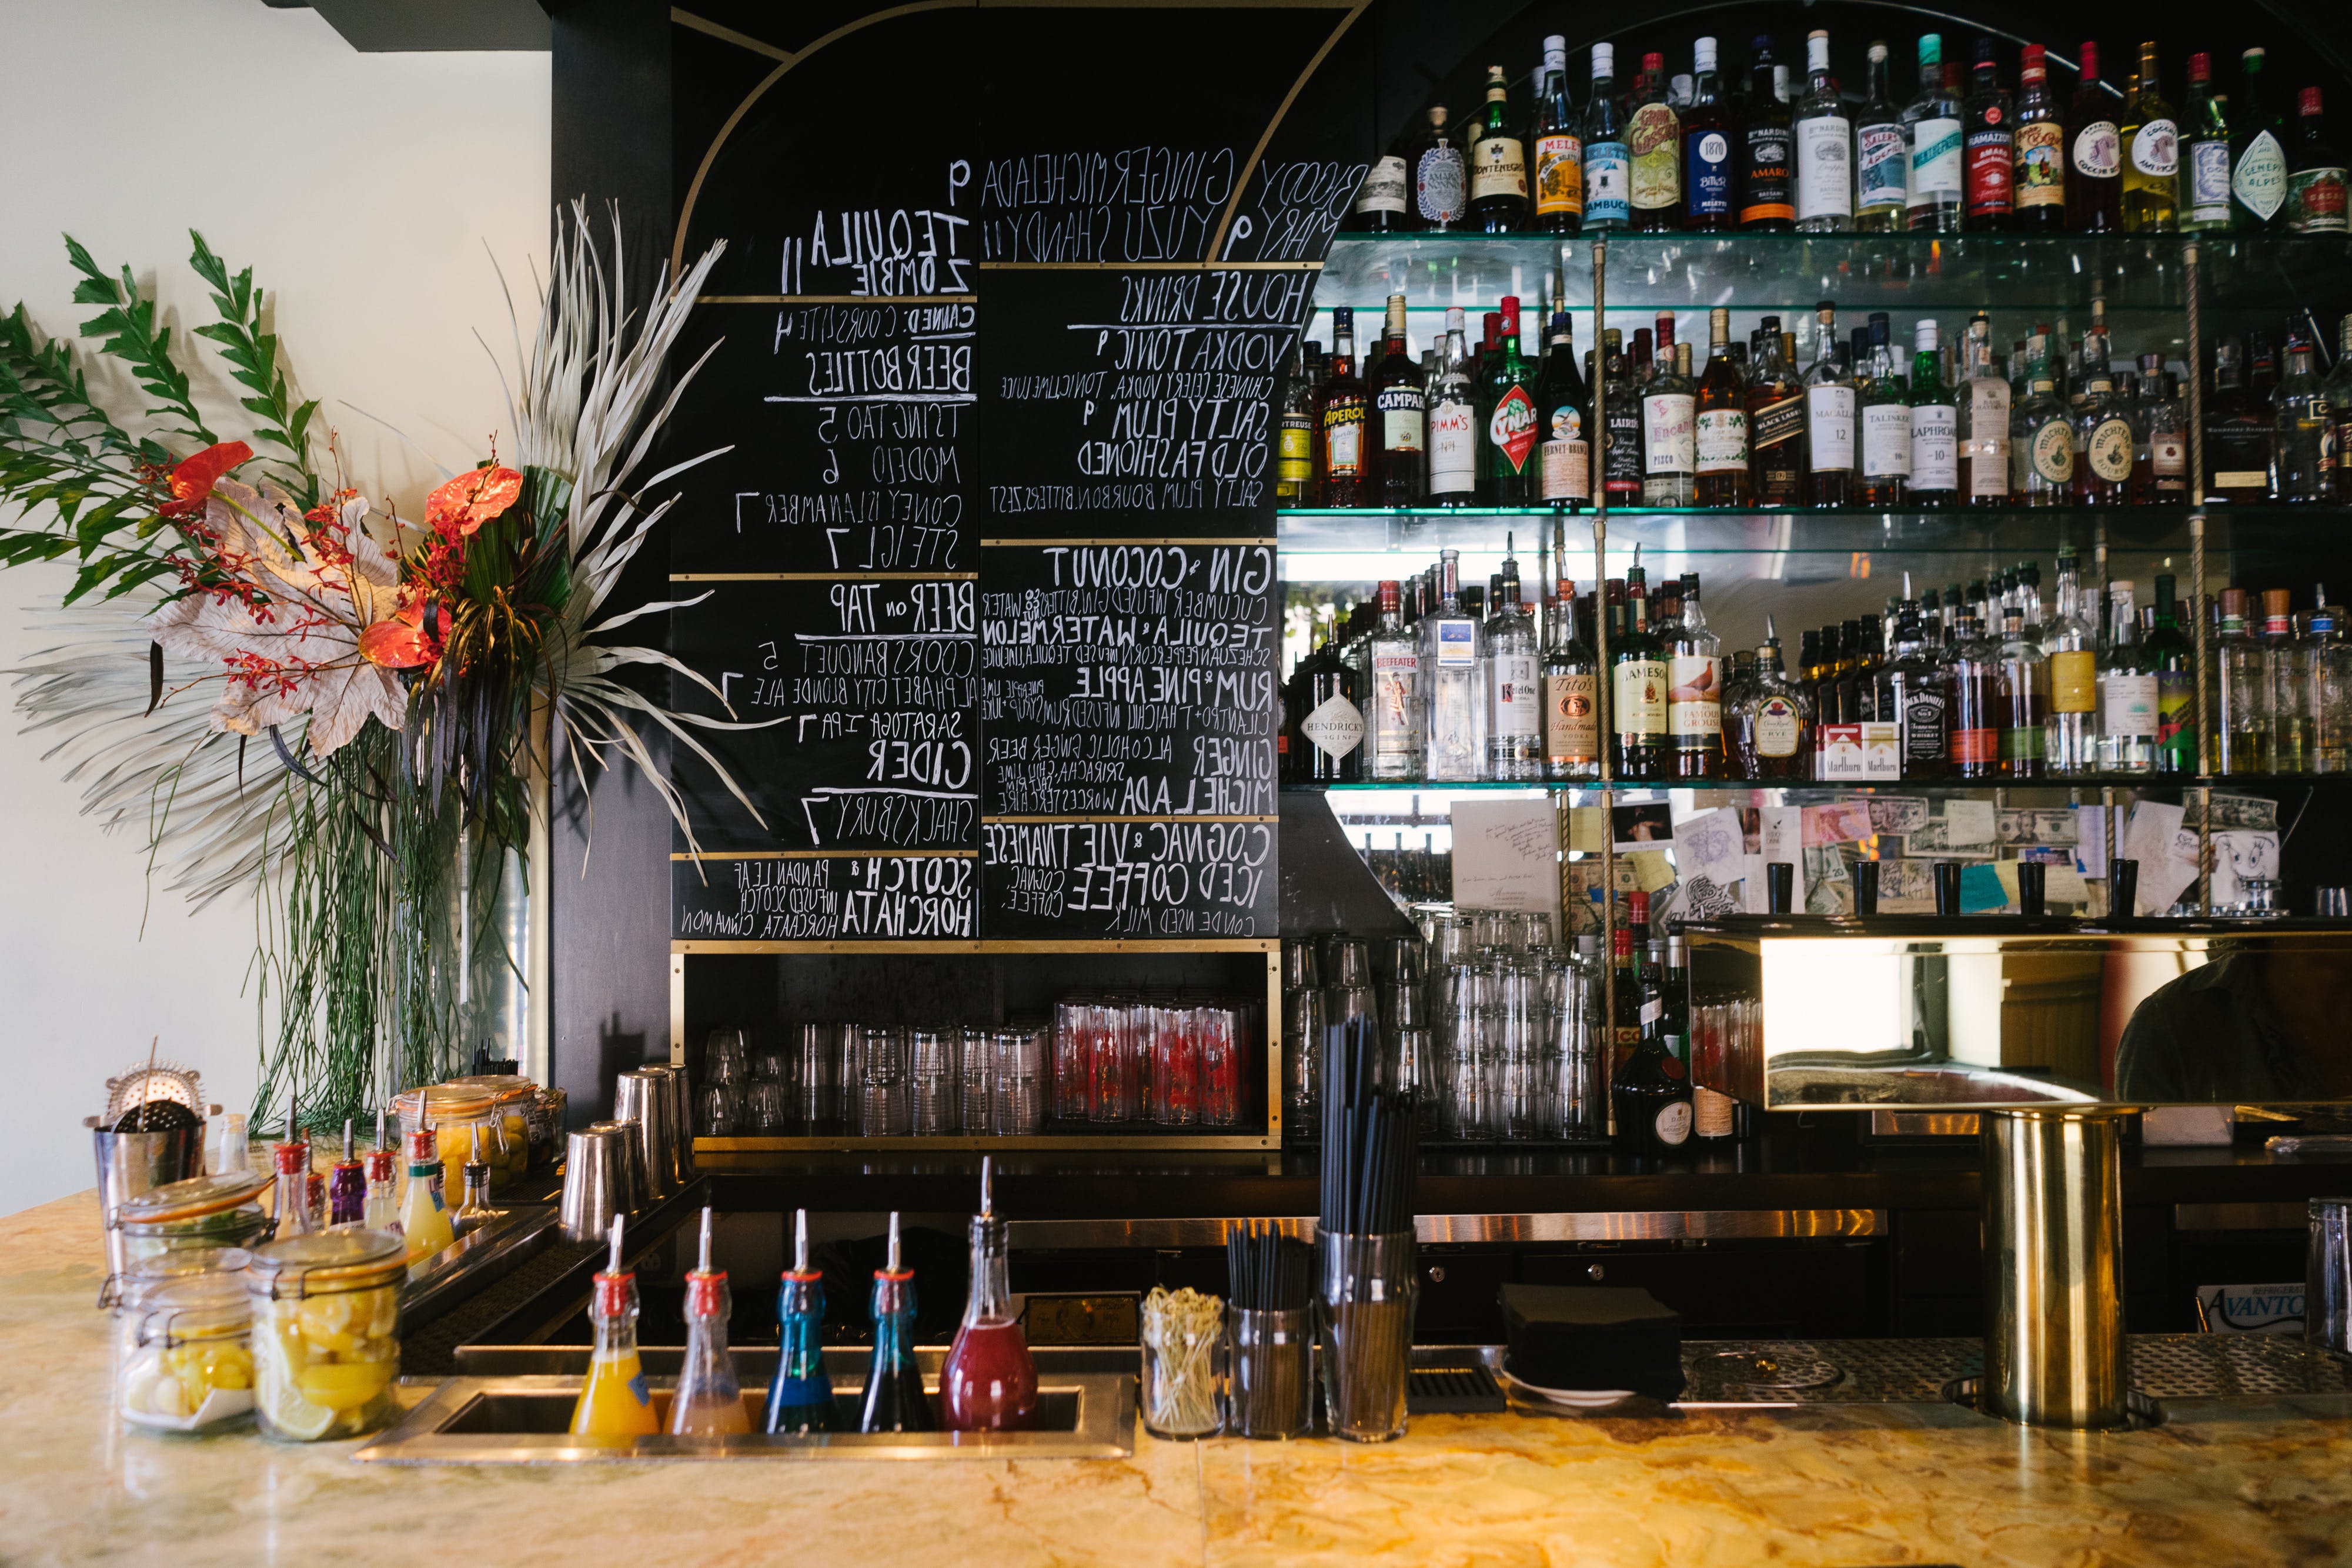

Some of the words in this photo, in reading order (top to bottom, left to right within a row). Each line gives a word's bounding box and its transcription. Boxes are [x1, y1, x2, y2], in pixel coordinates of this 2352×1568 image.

[1706, 142, 1723, 155] 1870
[1750, 168, 1789, 179] AMARO
[1324, 406, 1365, 427] APEROL
[1431, 414, 1469, 433] PIMM'S
[1490, 407, 1537, 446] CYNAR
[1757, 417, 1780, 430] BLACK
[1836, 429, 1846, 440] 12
[1653, 454, 1673, 465] PISCO
[1935, 450, 1945, 461] 10
[1377, 657, 1416, 668] BEEFEATER
[1622, 667, 1665, 682] JAMESO
[1555, 677, 1593, 692] Tito's
[1684, 710, 1719, 718] FAMOUS
[1307, 722, 1363, 731] HENDRICK'S
[1683, 719, 1719, 727] GROUSE
[1828, 757, 1861, 773] Marlboro
[1867, 757, 1897, 772] Marlboro
[1832, 868, 1845, 877] 20
